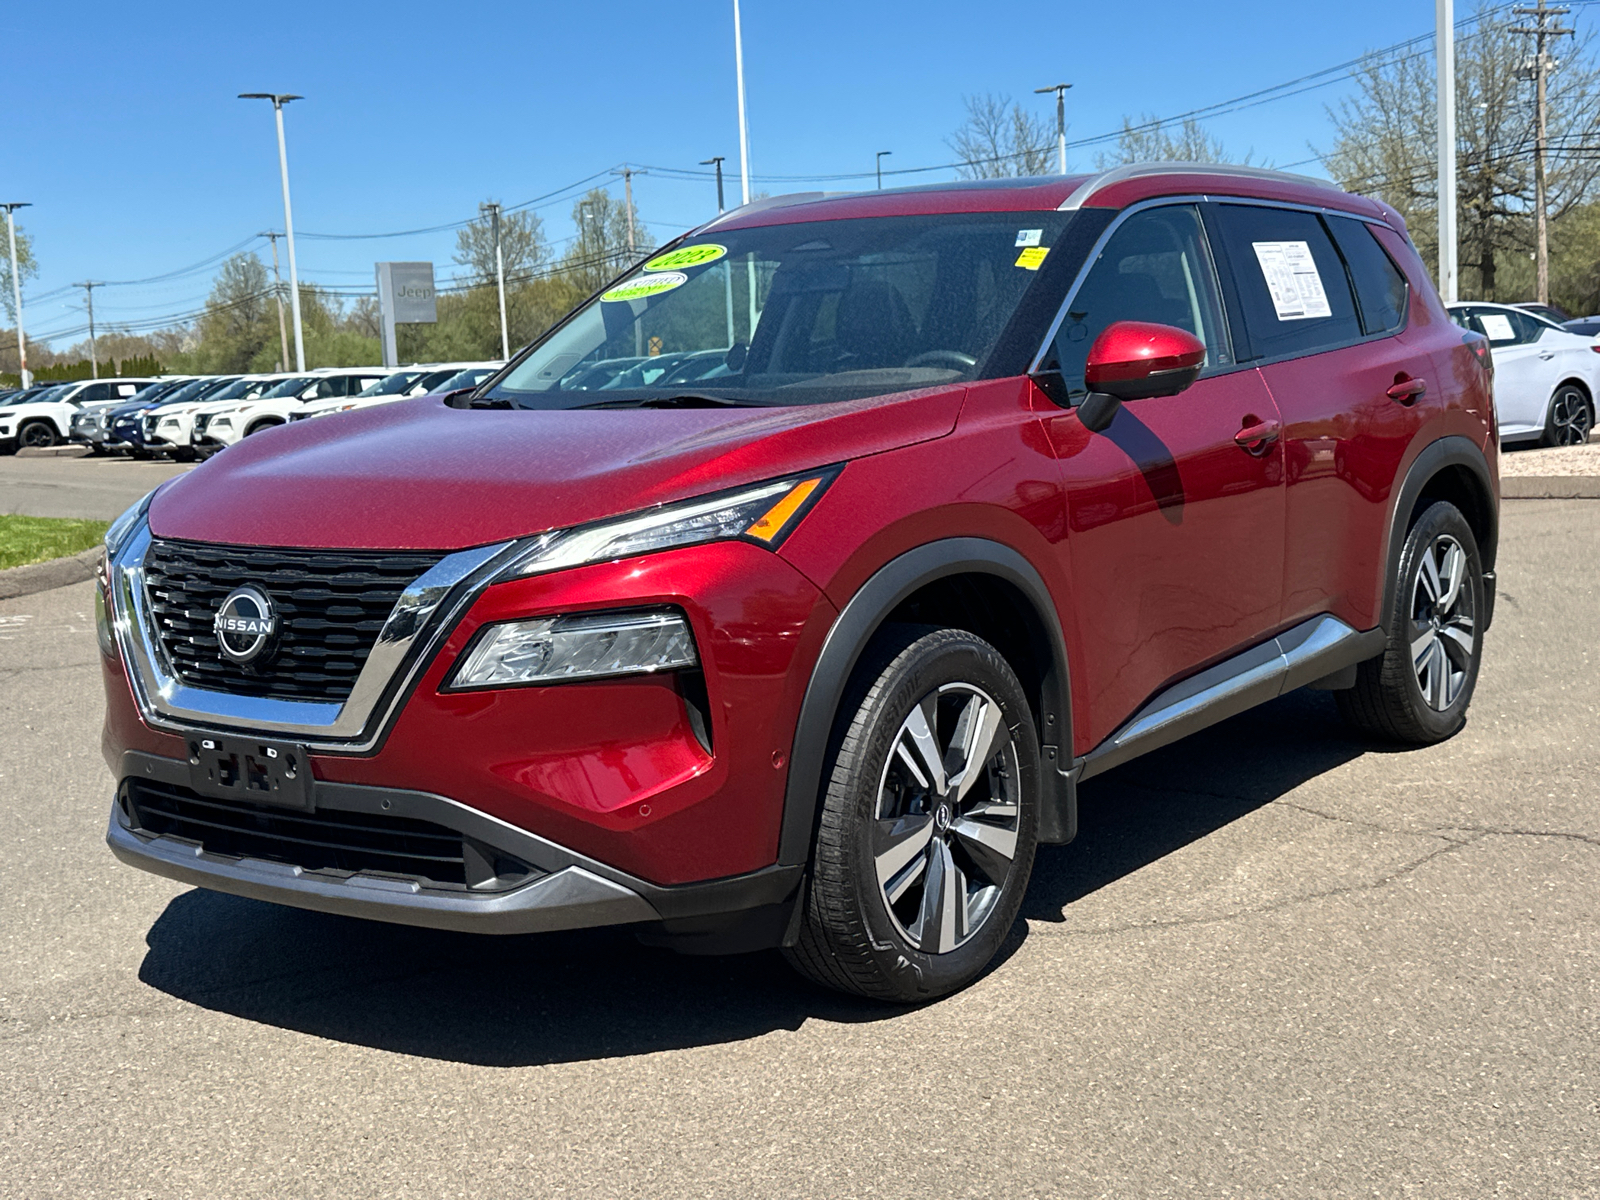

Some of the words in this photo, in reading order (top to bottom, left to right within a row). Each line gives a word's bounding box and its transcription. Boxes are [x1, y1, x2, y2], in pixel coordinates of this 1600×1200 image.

[651, 249, 716, 267] 2023
[397, 285, 431, 300] Jeep
[216, 617, 272, 633] NISSAN
